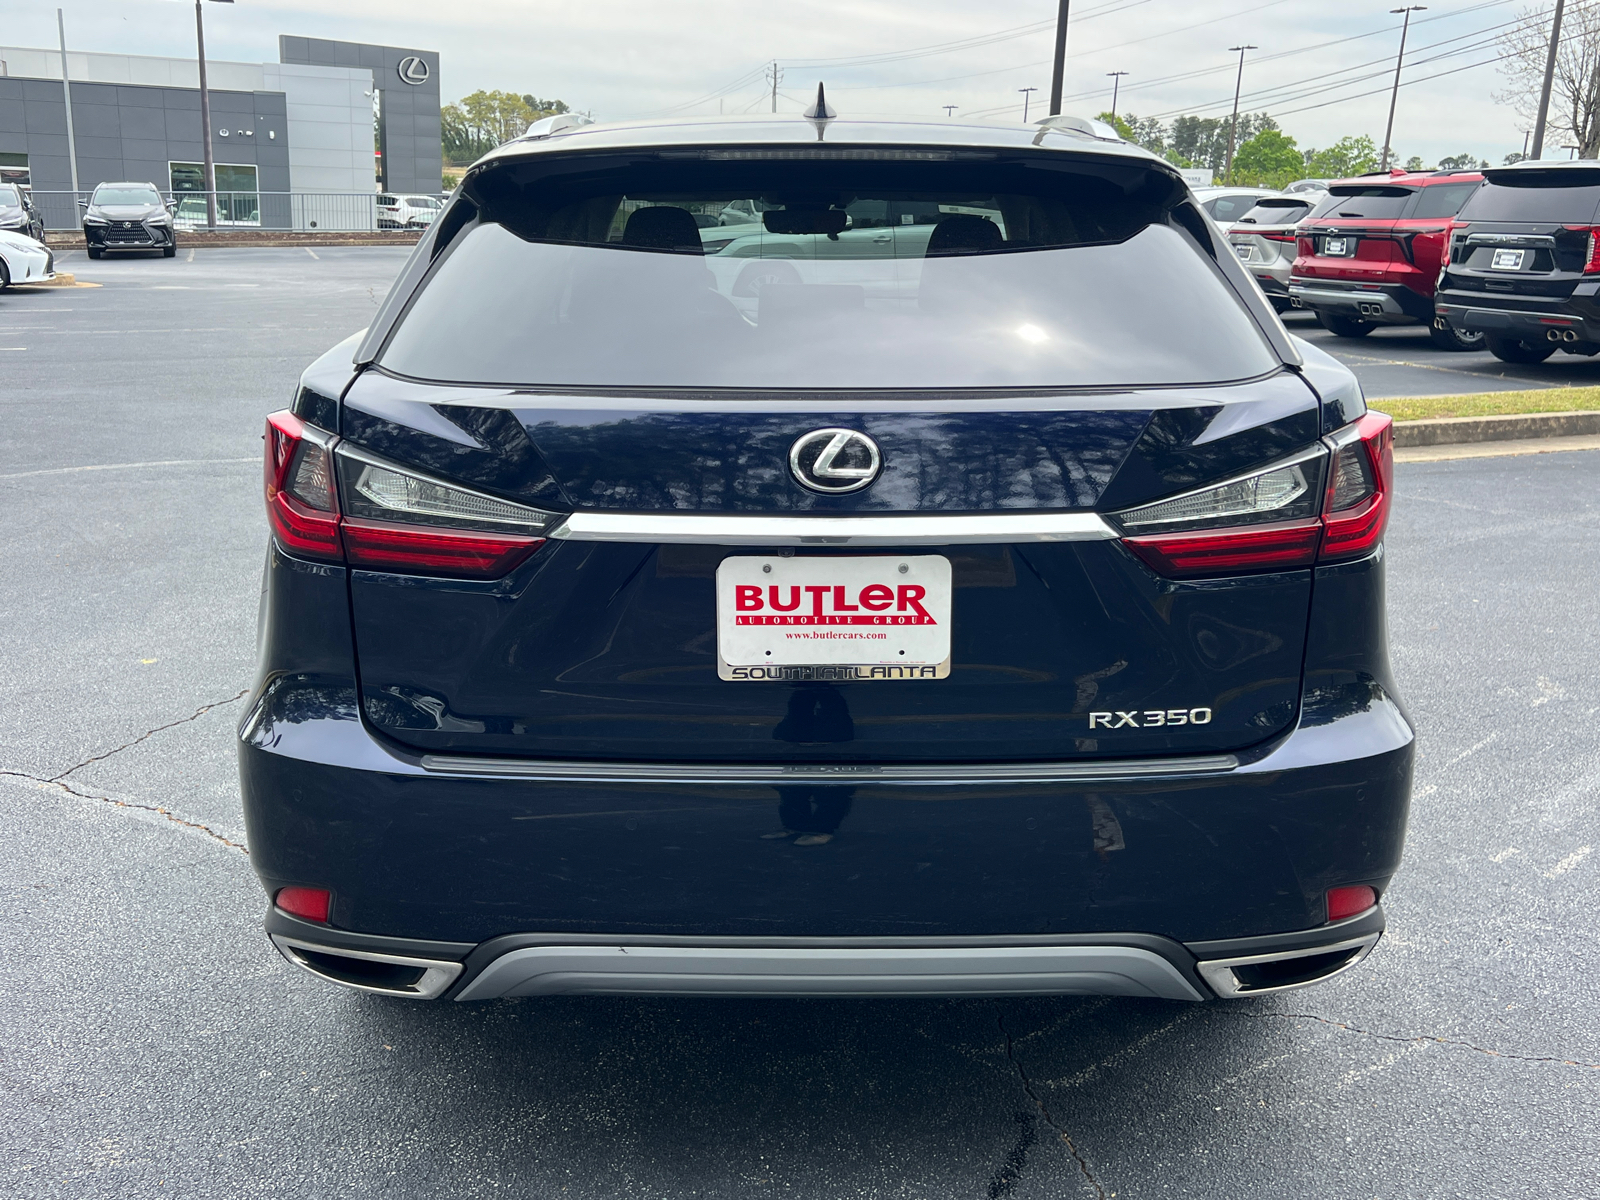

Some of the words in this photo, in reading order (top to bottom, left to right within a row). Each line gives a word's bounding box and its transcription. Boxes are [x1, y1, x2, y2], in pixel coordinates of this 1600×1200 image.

[737, 616, 853, 625] AUTOMOTIVE
[873, 616, 930, 625] GROUP
[785, 631, 887, 640] www.butlercars.com
[819, 665, 937, 679] ATLANTA
[1089, 710, 1140, 729] RX
[1143, 707, 1212, 727] 350
